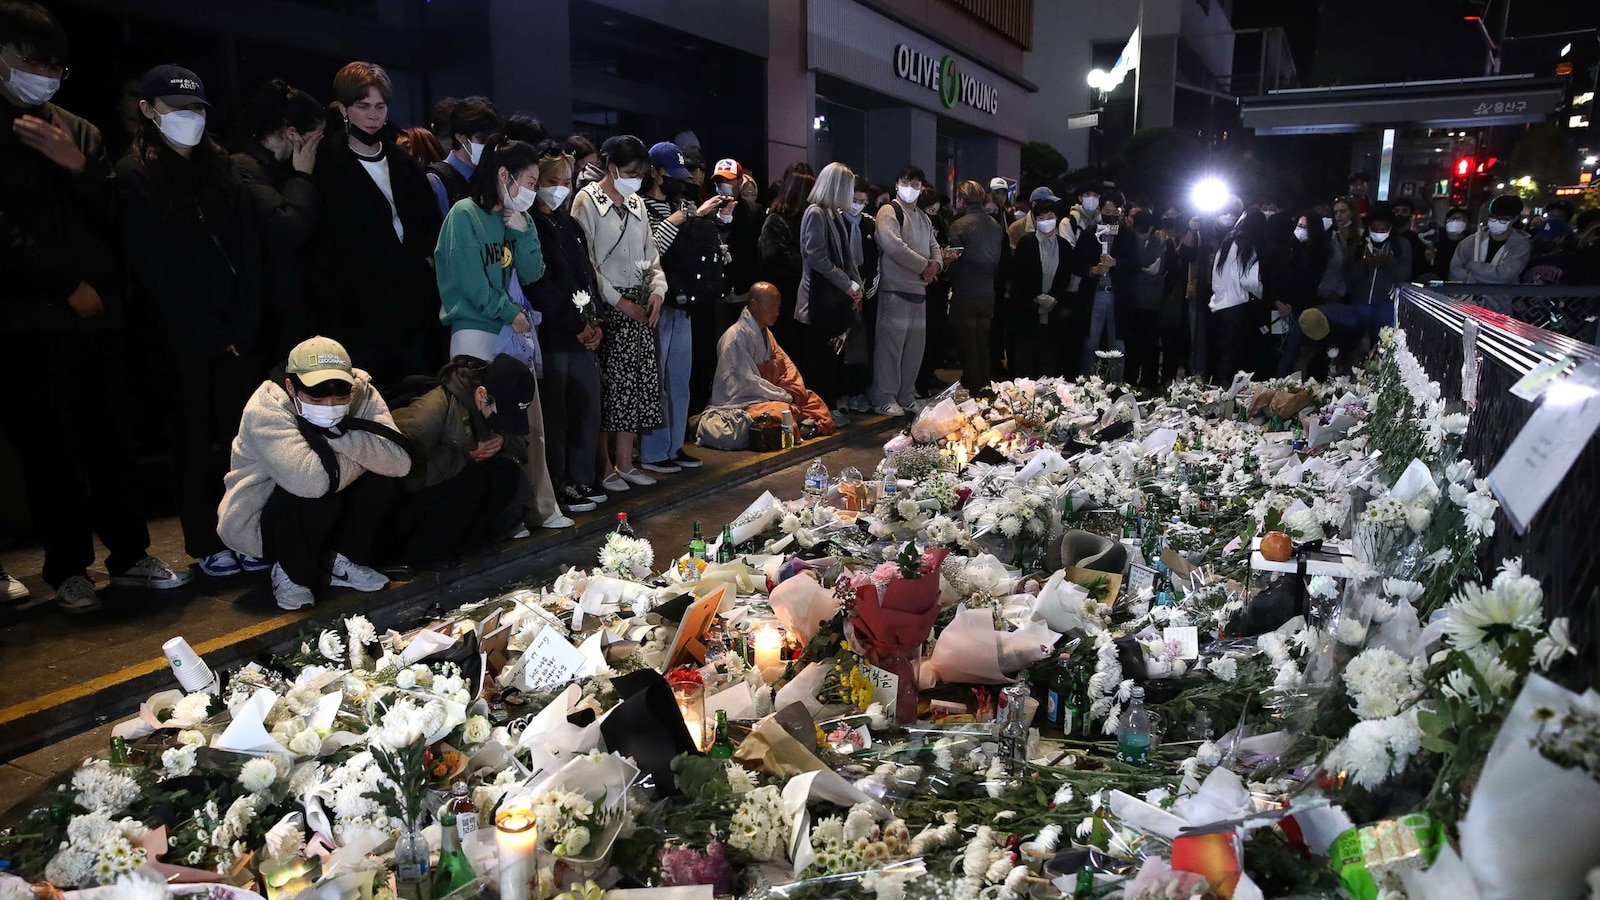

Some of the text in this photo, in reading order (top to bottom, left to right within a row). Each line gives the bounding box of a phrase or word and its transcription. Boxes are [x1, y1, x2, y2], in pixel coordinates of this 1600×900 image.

[896, 44, 998, 115] OLIVE YOUNG
[1494, 101, 1527, 113] 용산구
